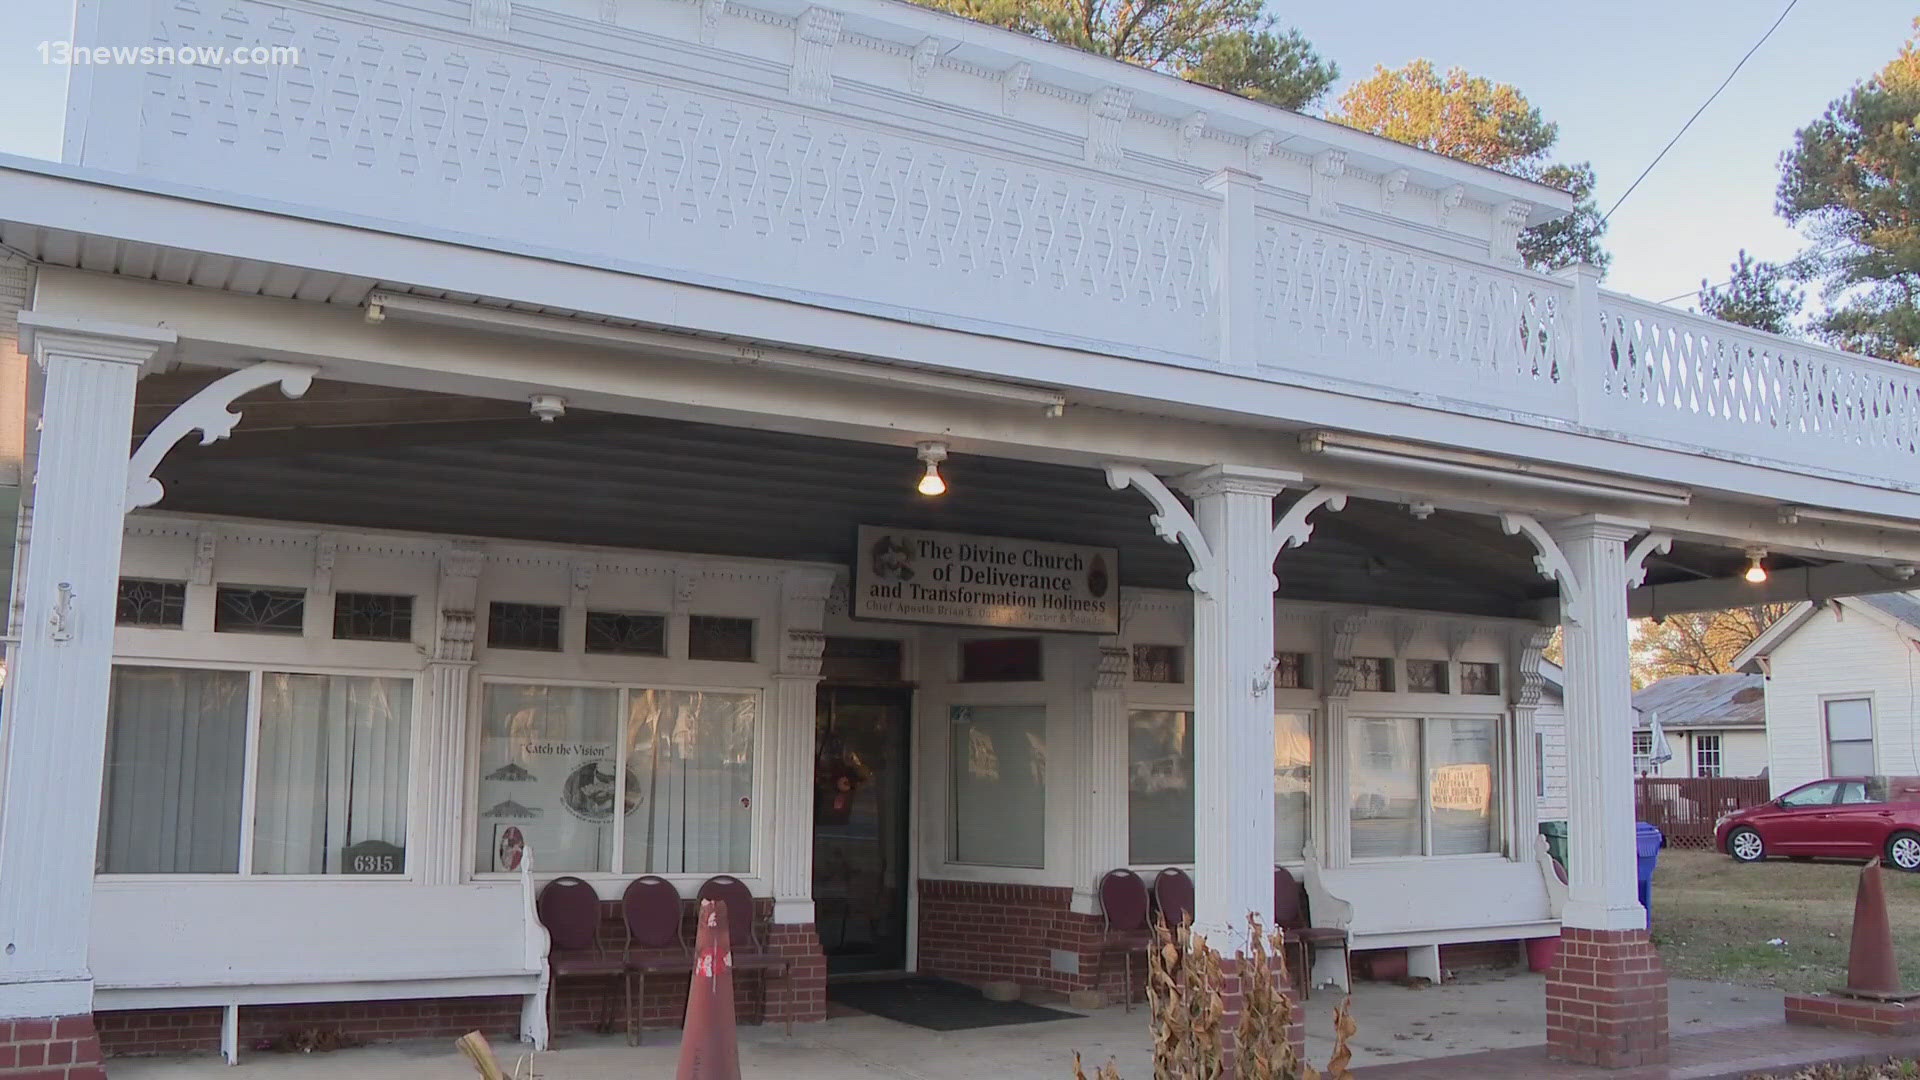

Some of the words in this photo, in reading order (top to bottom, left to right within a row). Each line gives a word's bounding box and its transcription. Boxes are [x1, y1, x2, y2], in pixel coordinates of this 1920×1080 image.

[917, 539, 953, 560] The
[959, 543, 1017, 566] Divine
[1023, 549, 1083, 572] Church
[933, 563, 953, 582] of
[960, 566, 1072, 591] Deliverance
[866, 600, 893, 612] Chief
[938, 605, 964, 617] Brian
[869, 582, 902, 599] and
[909, 583, 1037, 609] Transformation
[1042, 593, 1106, 613] Holiness
[556, 743, 572, 756] the
[354, 855, 393, 872] 6315
